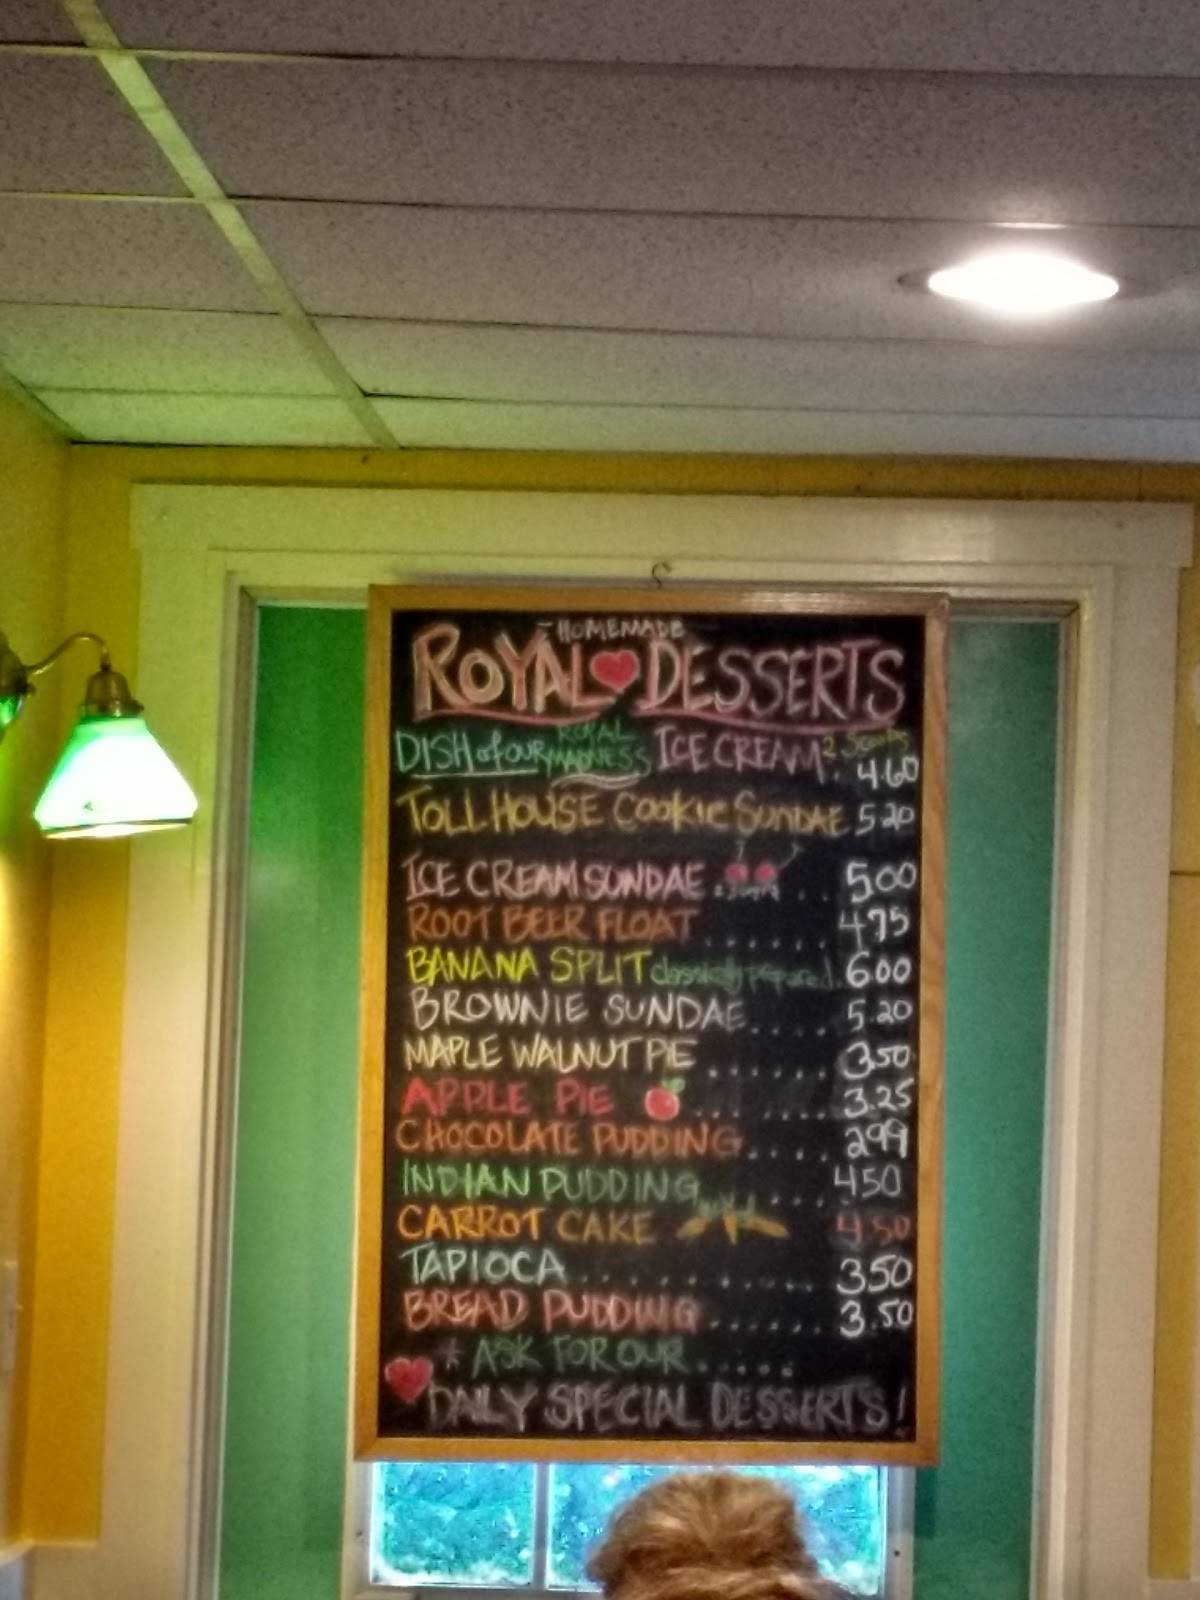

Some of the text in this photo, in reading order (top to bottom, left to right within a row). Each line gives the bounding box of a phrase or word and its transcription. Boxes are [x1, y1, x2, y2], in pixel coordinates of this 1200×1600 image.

[556, 618, 684, 642] HOMEMADE
[413, 622, 905, 720] ROYAL DESSERTS
[396, 730, 475, 773] DISH
[654, 725, 826, 784] ICE CREAM
[822, 735, 836, 757] 2
[396, 785, 488, 835] TOLL
[491, 787, 605, 835] HOUSE
[401, 851, 461, 901] ICE
[466, 858, 580, 900] CREAM
[583, 859, 705, 901] SUNDAE
[408, 902, 700, 943] ROOT BEER FLOAT
[406, 946, 540, 987] BANANA
[550, 946, 653, 986] SPLIT
[409, 986, 746, 1031] BROWNIE SUNDAE
[403, 1031, 698, 1074] MAPLE WALNUT PIE
[401, 1077, 616, 1117] APPLE PIE
[396, 1118, 744, 1158] CHOCOLATE PUDDING
[403, 1158, 700, 1201] INDIAN PUDDING
[397, 1203, 658, 1246] CARROT CAKE
[399, 1240, 567, 1286] TAPIOCA
[404, 1288, 699, 1334] BREAD PUDDING
[472, 1333, 690, 1378] ASK FOR OUR
[428, 1380, 539, 1432] DAILY
[544, 1381, 702, 1432] SPECIAL
